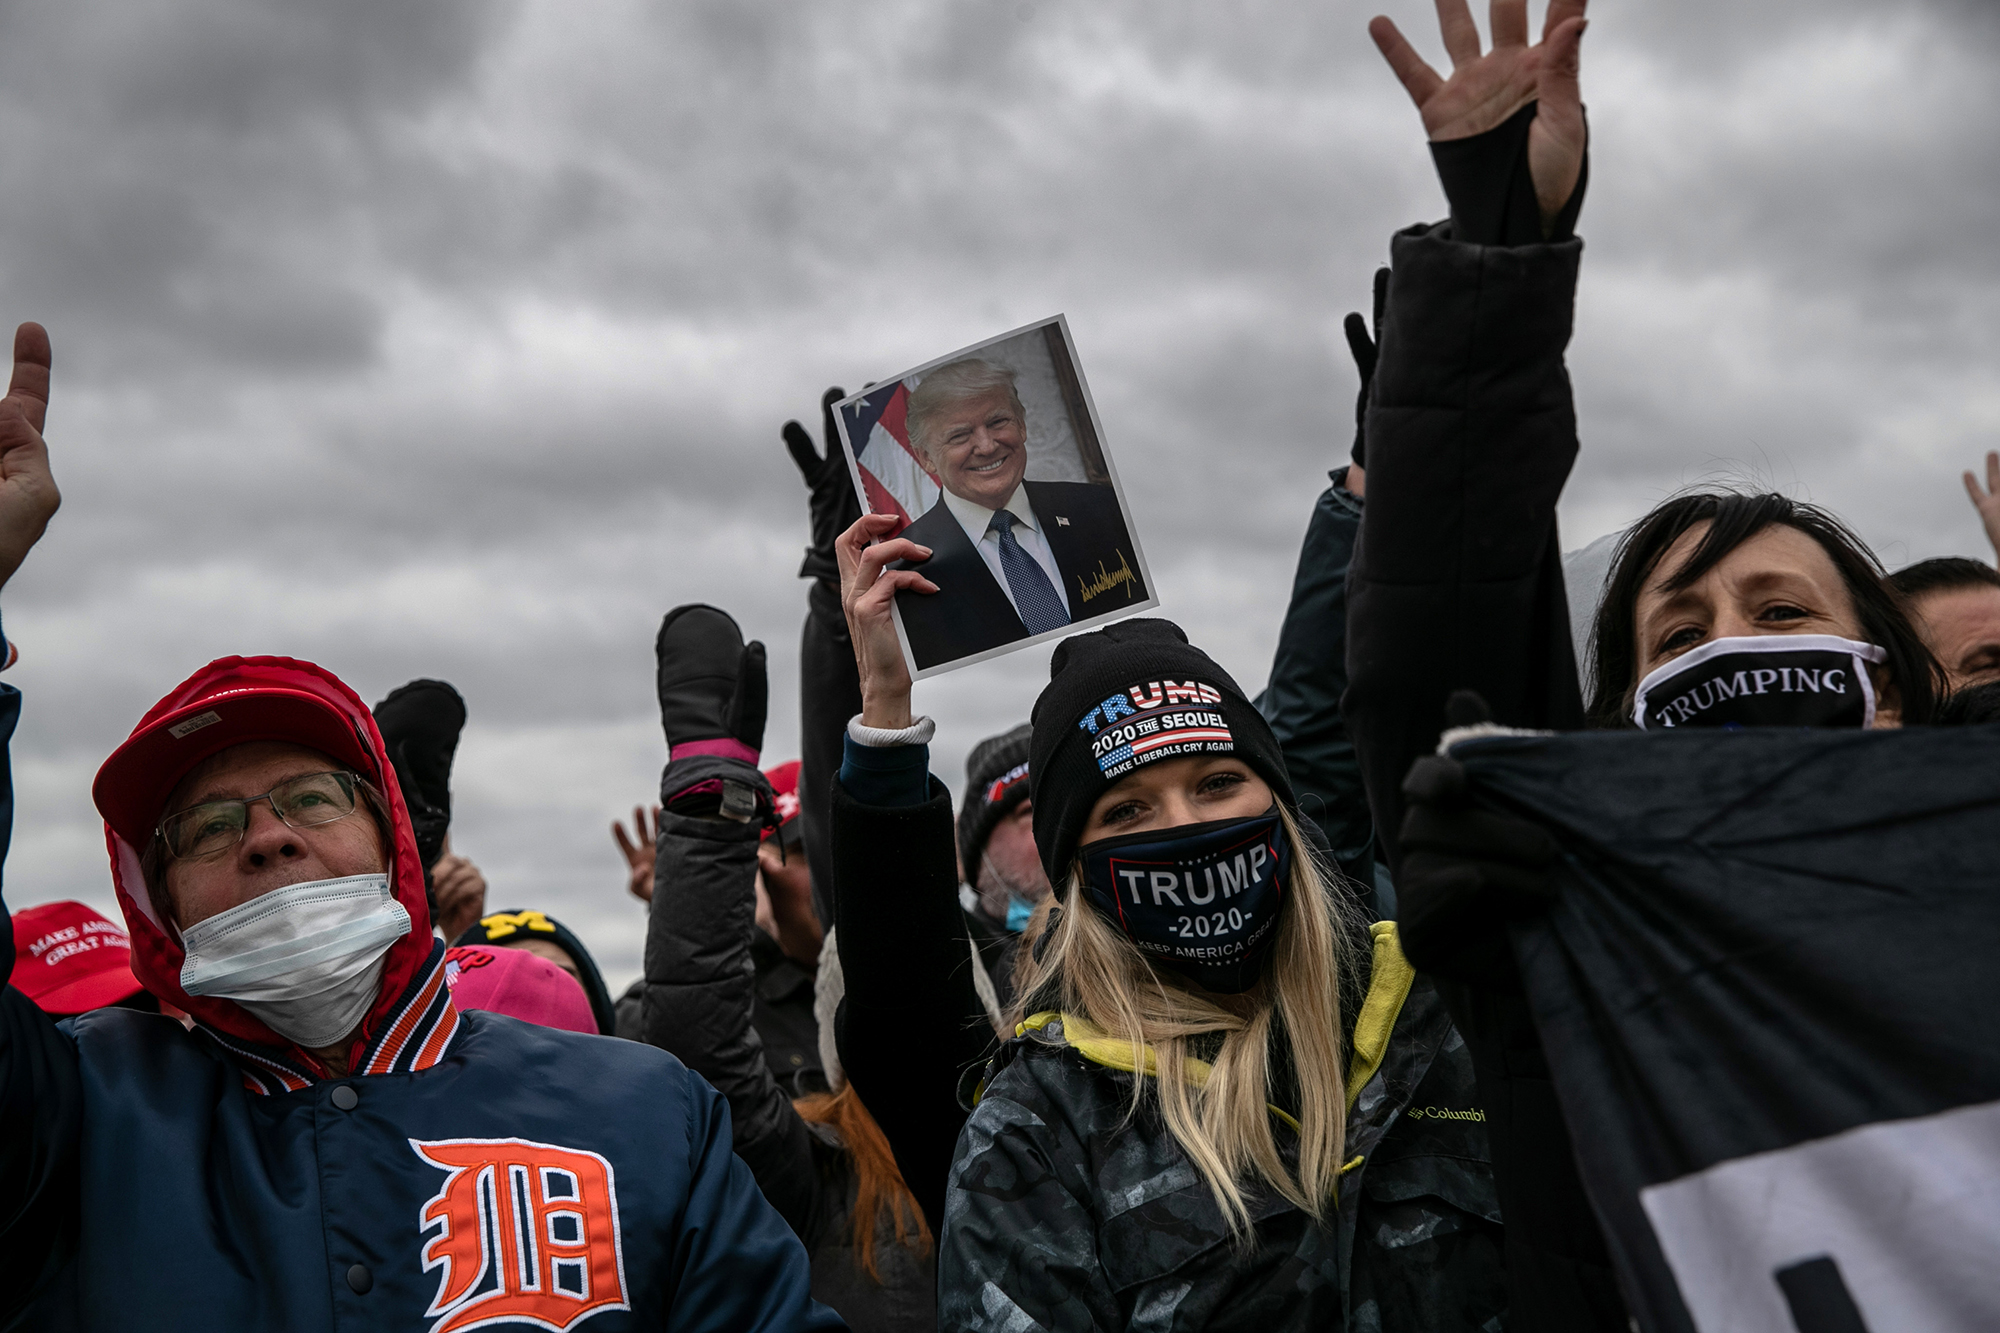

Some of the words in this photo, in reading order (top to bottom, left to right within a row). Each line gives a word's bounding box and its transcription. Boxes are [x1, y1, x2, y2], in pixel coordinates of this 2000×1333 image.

[1078, 680, 1222, 734] TRUMP
[1656, 667, 1846, 728] TRUMPING
[1092, 725, 1137, 758] 2020
[1136, 719, 1159, 735] THE
[1161, 712, 1229, 729] SEQUEL
[1104, 760, 1134, 779] MAKE
[1133, 744, 1182, 766] LIBERALS
[1183, 742, 1203, 753] CRY
[1206, 742, 1234, 751] AGAIN
[1119, 843, 1267, 907] TRUMP
[480, 910, 556, 940] M
[1168, 907, 1253, 938] -2020-
[29, 926, 80, 957] MAKE
[46, 936, 100, 967] GREAT
[1175, 941, 1244, 959] AMERICA
[1425, 1105, 1487, 1122] Columbi
[408, 1137, 631, 1333] D
